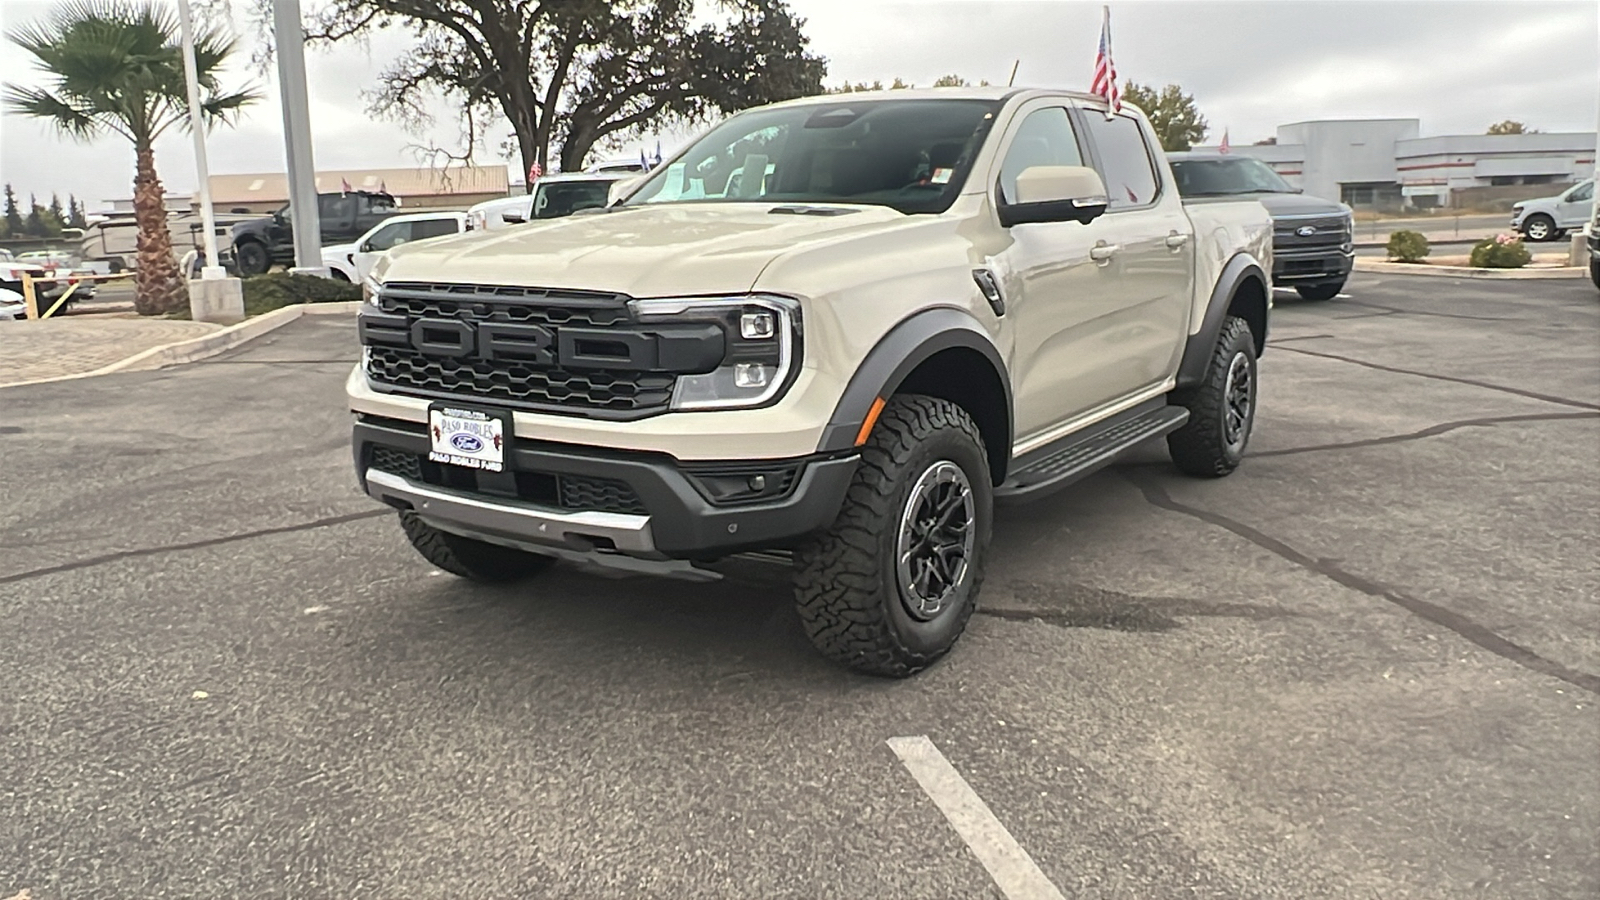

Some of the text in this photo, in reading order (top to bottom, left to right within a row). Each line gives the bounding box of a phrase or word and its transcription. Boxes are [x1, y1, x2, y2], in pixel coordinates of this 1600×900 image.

[358, 312, 659, 371] FORD
[441, 419, 494, 440] PASO ROBLES
[453, 436, 481, 451] Ford
